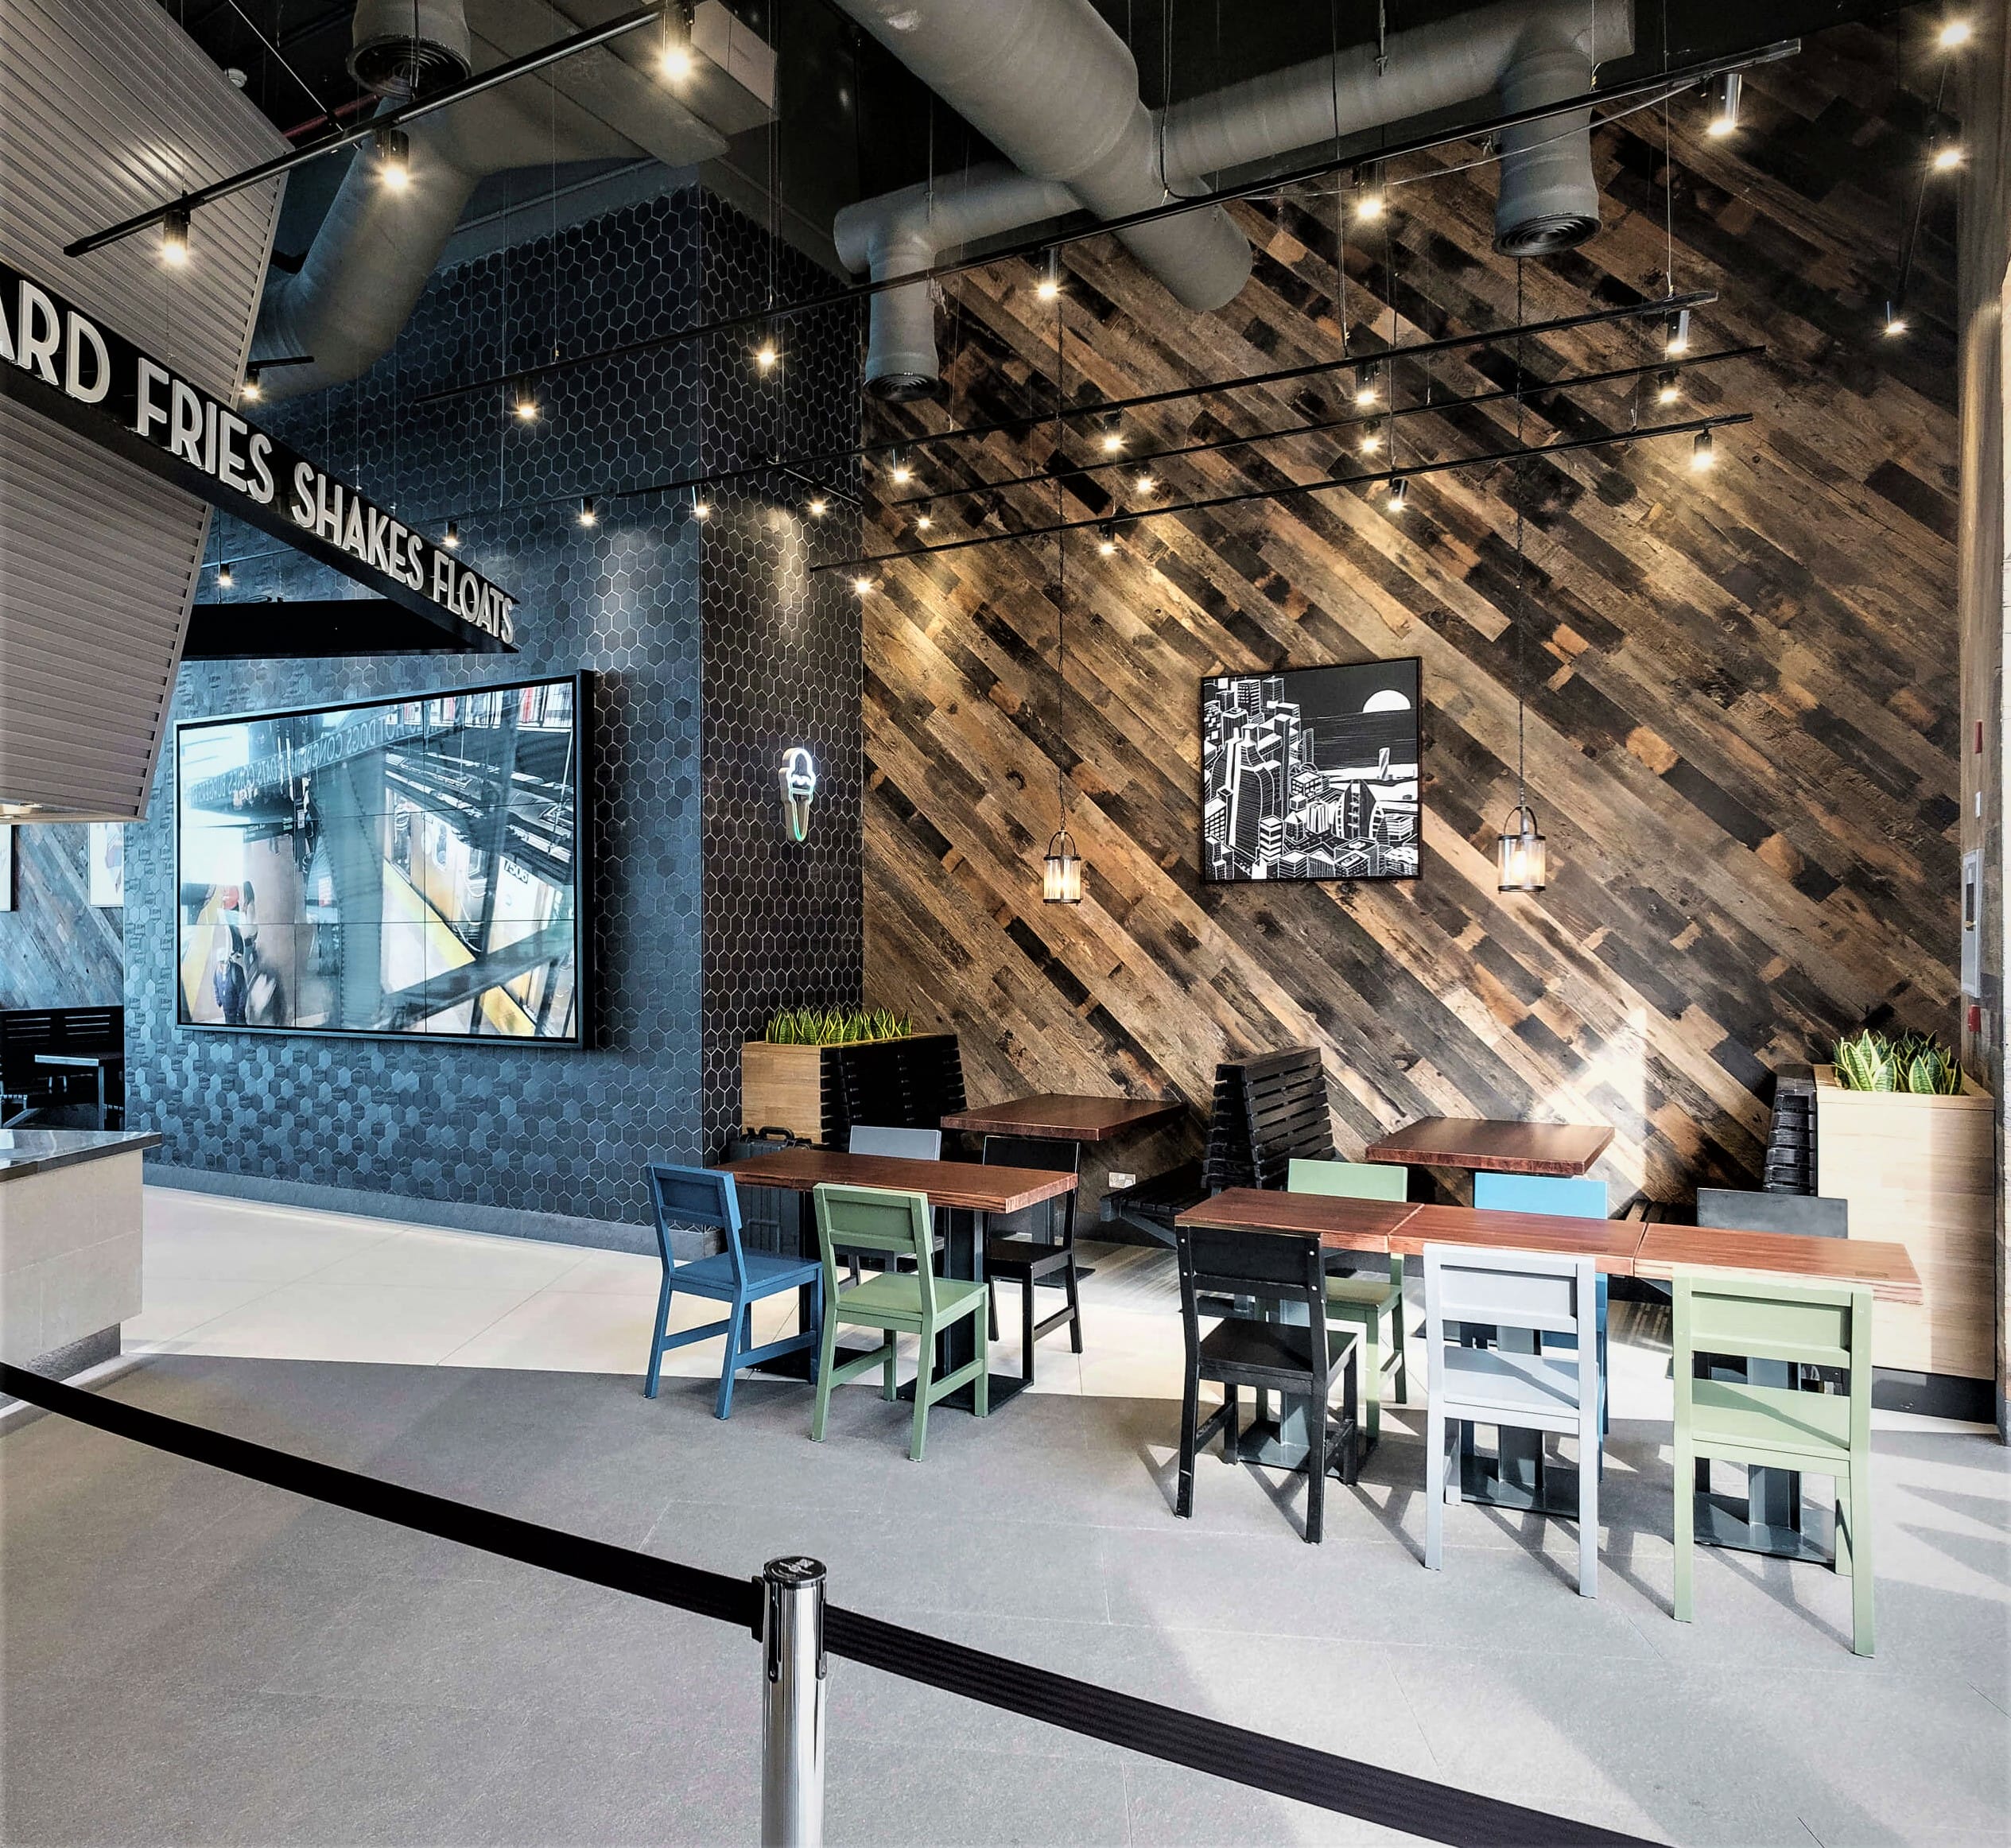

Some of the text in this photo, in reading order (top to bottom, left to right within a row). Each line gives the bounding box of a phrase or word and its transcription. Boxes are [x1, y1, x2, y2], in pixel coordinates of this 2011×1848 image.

[137, 357, 274, 503] FRIES
[291, 462, 424, 590] SHAKES
[433, 550, 514, 643] FLOATS
